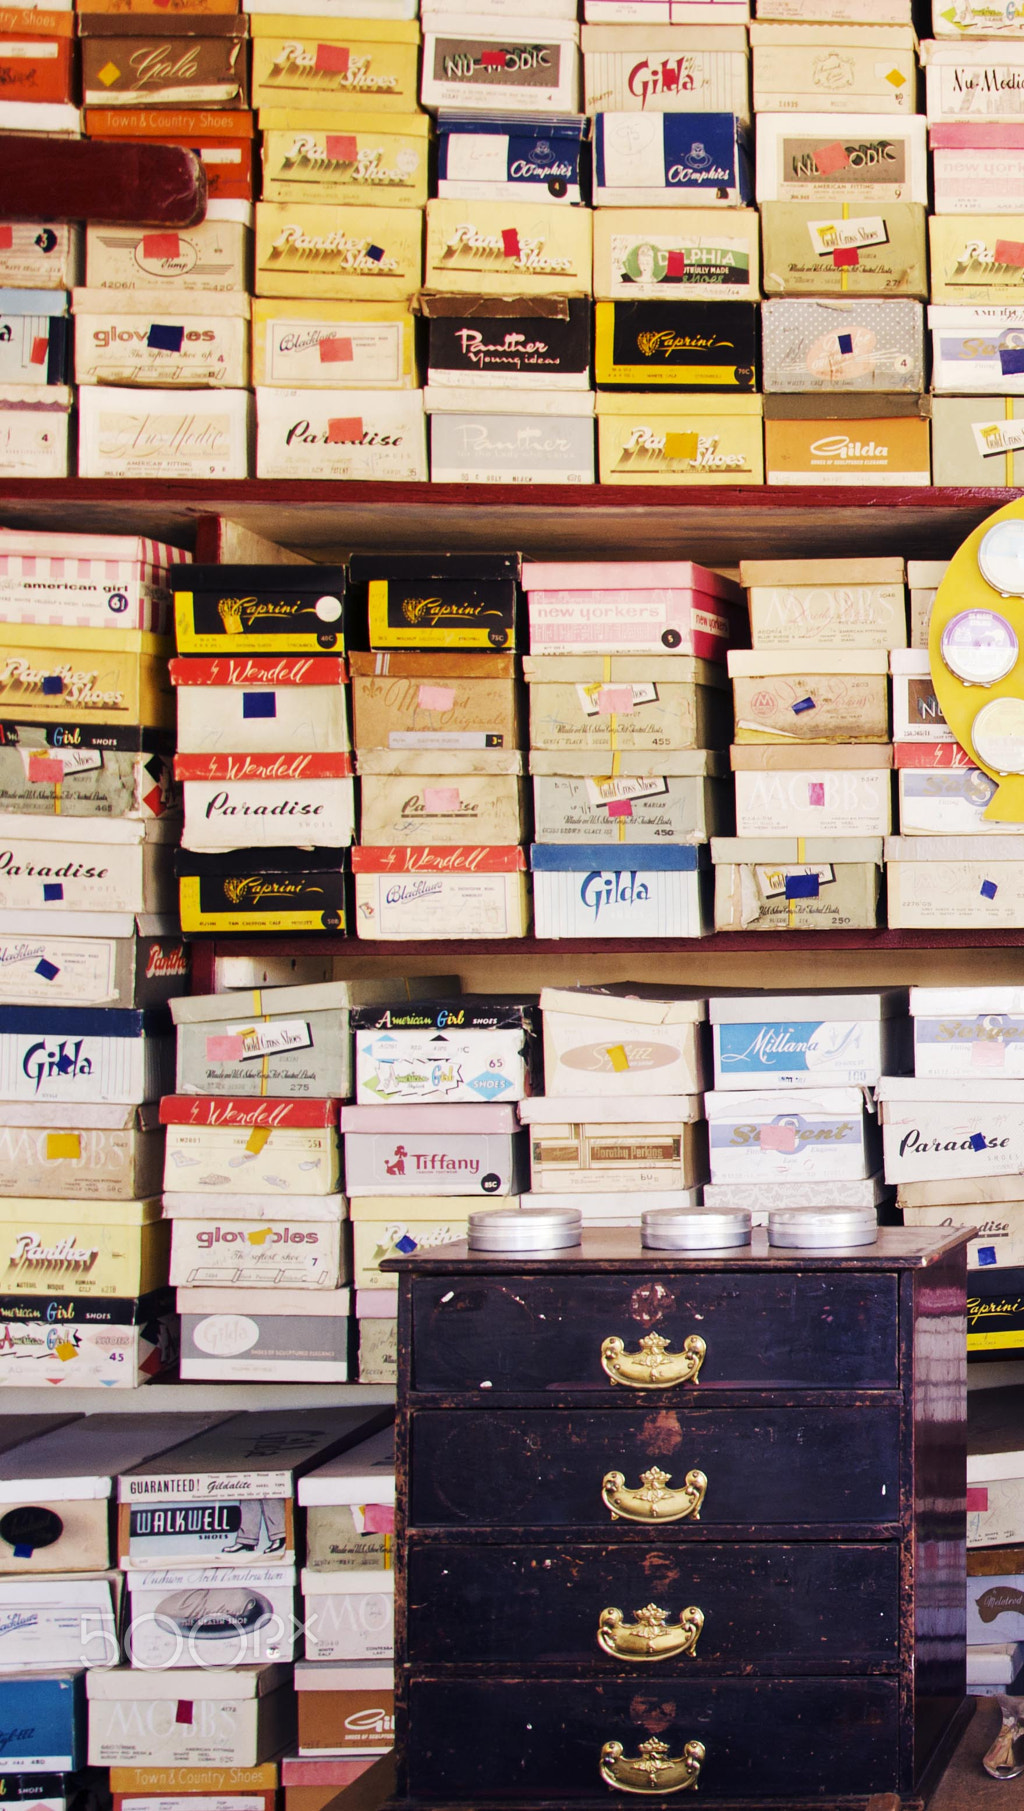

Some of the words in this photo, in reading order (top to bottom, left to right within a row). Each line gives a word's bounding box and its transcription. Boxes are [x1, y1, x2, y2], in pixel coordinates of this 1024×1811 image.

[129, 45, 201, 90] Gala
[340, 67, 399, 91] Shoes
[107, 113, 141, 128] Town
[150, 112, 197, 132] Country
[200, 113, 235, 129] Shoes
[275, 224, 371, 252] Panther
[514, 250, 573, 273] Shoes
[455, 328, 549, 355] Panther
[469, 354, 521, 371] Young
[524, 354, 560, 366] ideas
[811, 435, 890, 461] Gilda
[22, 582, 98, 593] american
[102, 583, 128, 595] girl
[537, 606, 573, 619] new
[577, 605, 661, 624] yorkers
[3, 656, 98, 682] Panther
[229, 658, 314, 686] Wendell
[65, 677, 125, 704] Shoes
[53, 726, 82, 748] Girl
[91, 737, 118, 747] SHOES
[652, 738, 672, 747] 455
[227, 753, 311, 782] Wendell
[205, 790, 326, 820] Paradise
[654, 828, 674, 838] 450
[402, 843, 491, 872] Wendell
[580, 870, 652, 924] Gilda
[831, 917, 851, 926] 250
[375, 1010, 432, 1029] American
[436, 1008, 466, 1027] Girl
[472, 1017, 498, 1026] SHOES
[489, 1059, 504, 1070] 65
[290, 1084, 310, 1093] 275
[472, 1078, 508, 1090] SHOES
[205, 1101, 295, 1127] Wendell
[411, 1150, 481, 1175] Tiffany
[10, 1231, 99, 1260] Panther
[311, 1257, 319, 1267] 7
[45, 1302, 77, 1321] Girl
[85, 1311, 113, 1321] SHOES
[109, 1351, 126, 1362] 45
[129, 1479, 200, 1497] GUARANTEED!
[206, 1480, 252, 1492] Gildalite
[136, 1503, 230, 1534] WALKWELL
[135, 1768, 166, 1784] Town
[178, 1769, 225, 1790] Country
[229, 1767, 264, 1786] Shoes
